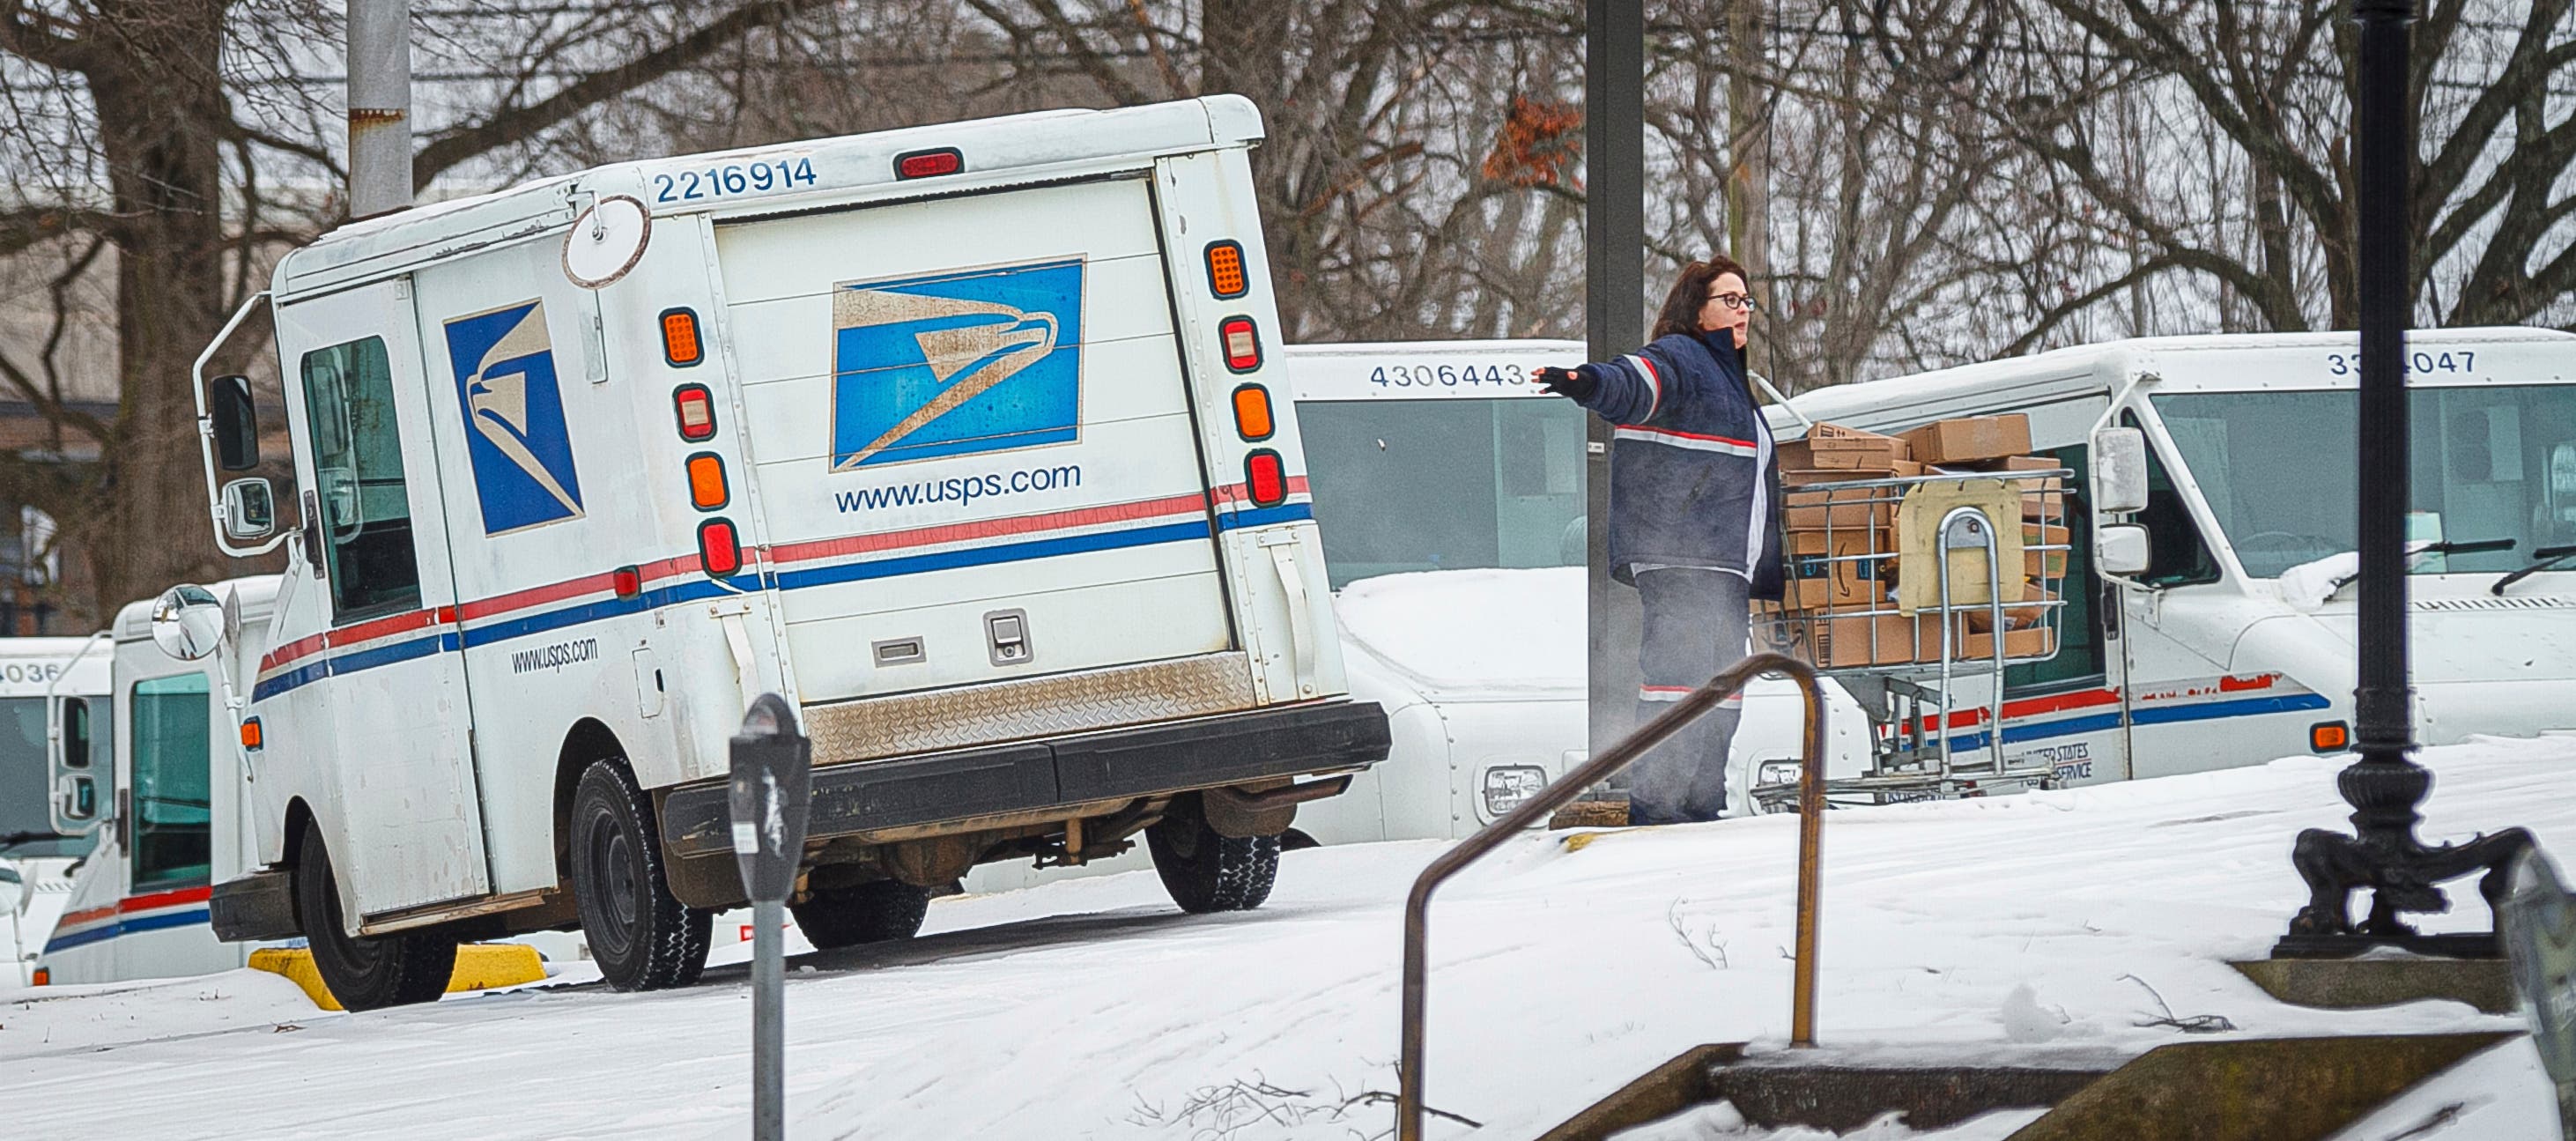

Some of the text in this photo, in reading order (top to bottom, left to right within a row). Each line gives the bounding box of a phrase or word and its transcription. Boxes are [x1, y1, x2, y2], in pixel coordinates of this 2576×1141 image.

[655, 157, 817, 203] 2216914
[1370, 364, 1526, 388] 4306443
[835, 464, 1081, 513] www.usps.com
[511, 637, 598, 674] www.usps.com
[2057, 742, 2089, 762] STATES
